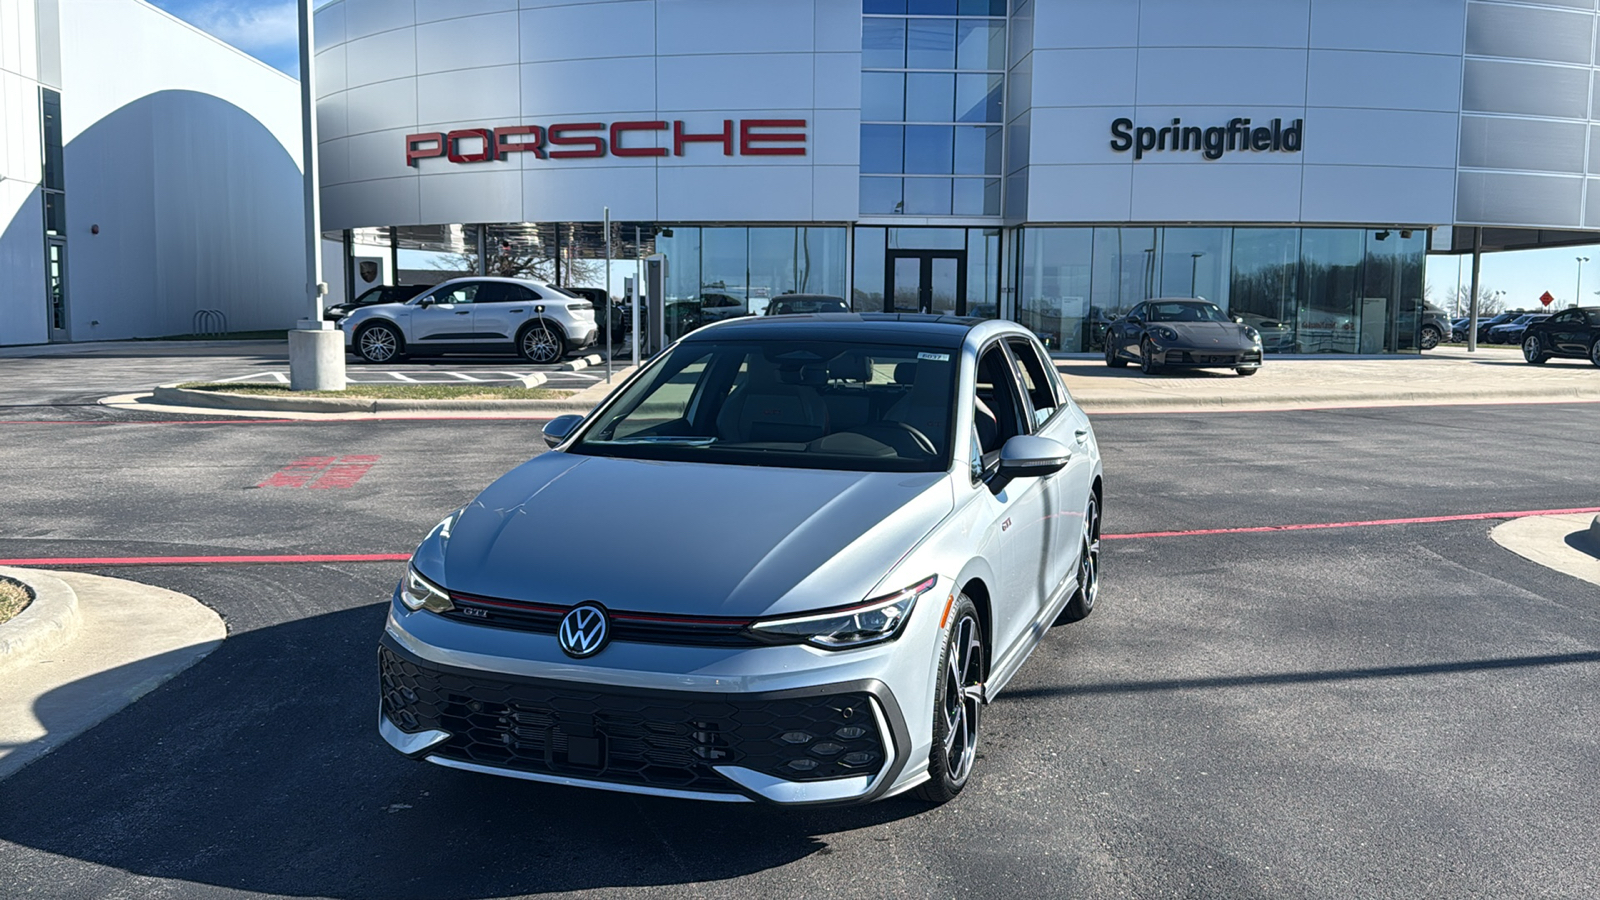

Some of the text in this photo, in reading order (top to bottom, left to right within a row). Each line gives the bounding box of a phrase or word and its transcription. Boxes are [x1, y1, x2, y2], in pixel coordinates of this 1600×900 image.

[406, 119, 807, 167] PORSCHE
[1110, 117, 1303, 160] Springfield
[463, 606, 489, 618] GTI
[562, 608, 603, 651] VW
